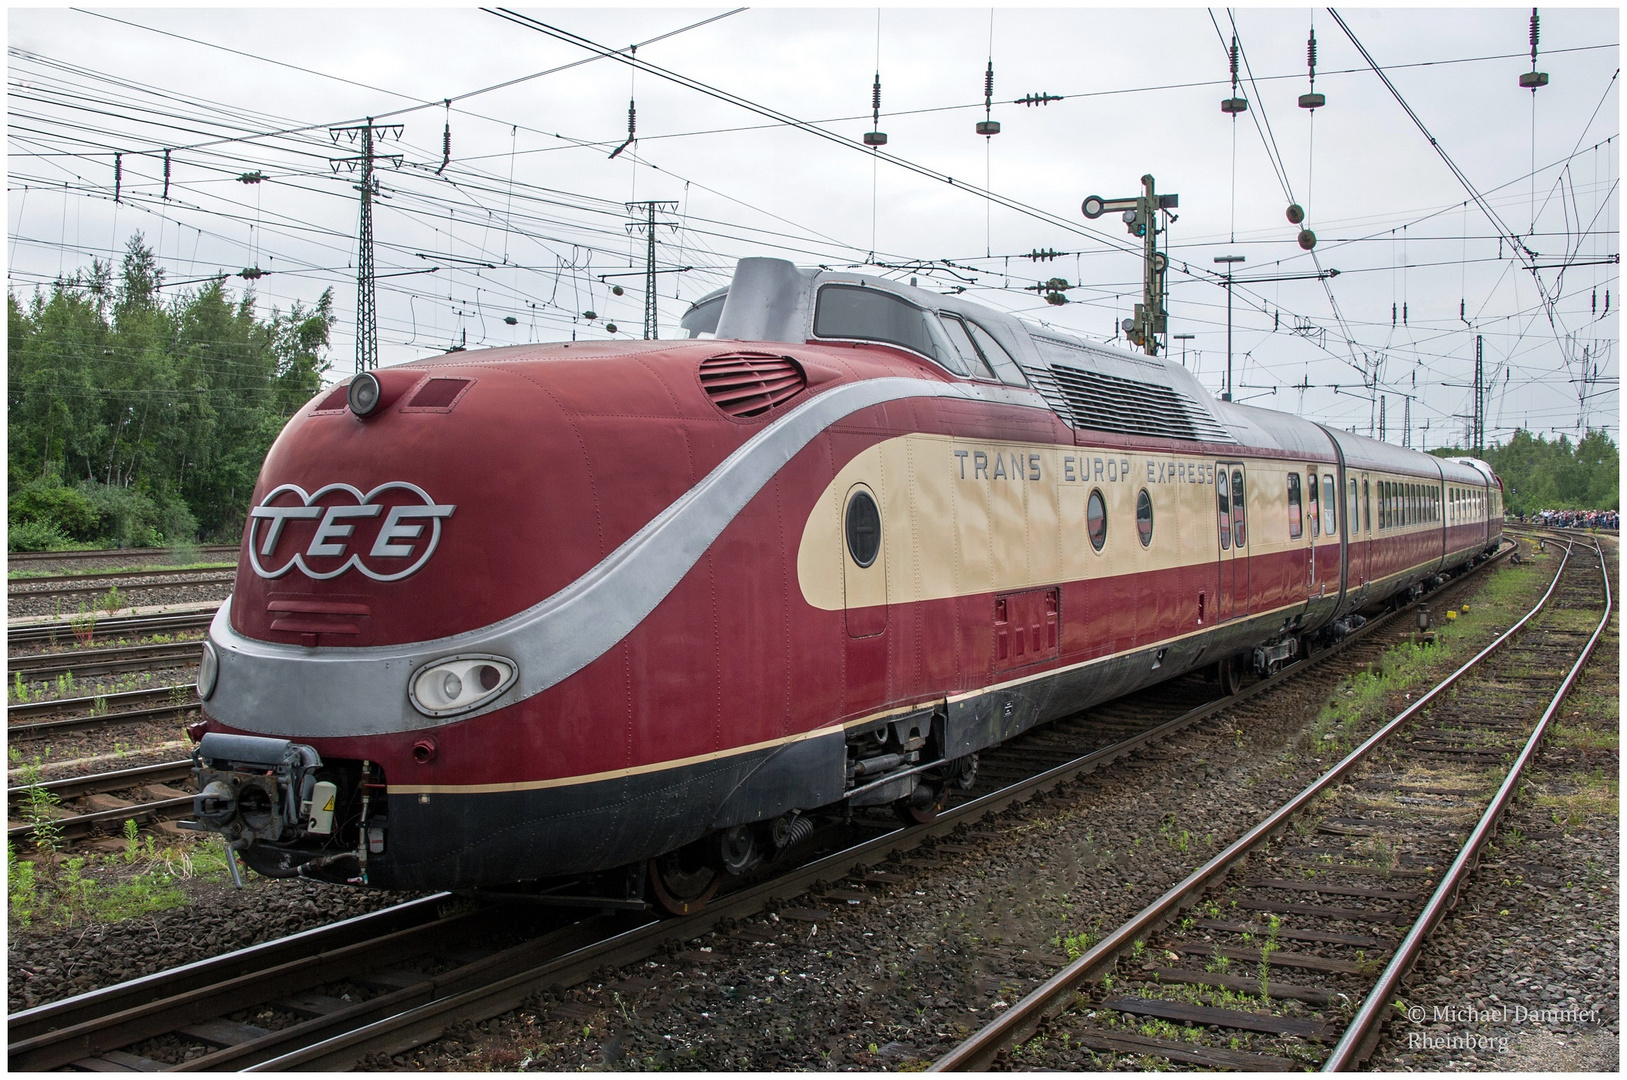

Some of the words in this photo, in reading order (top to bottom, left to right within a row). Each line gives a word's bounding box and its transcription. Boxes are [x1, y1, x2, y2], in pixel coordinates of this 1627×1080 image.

[954, 450, 1041, 480] TRANS
[1064, 456, 1129, 482] EUROP
[1146, 460, 1213, 484] EXPRESS
[250, 504, 457, 557] TEE
